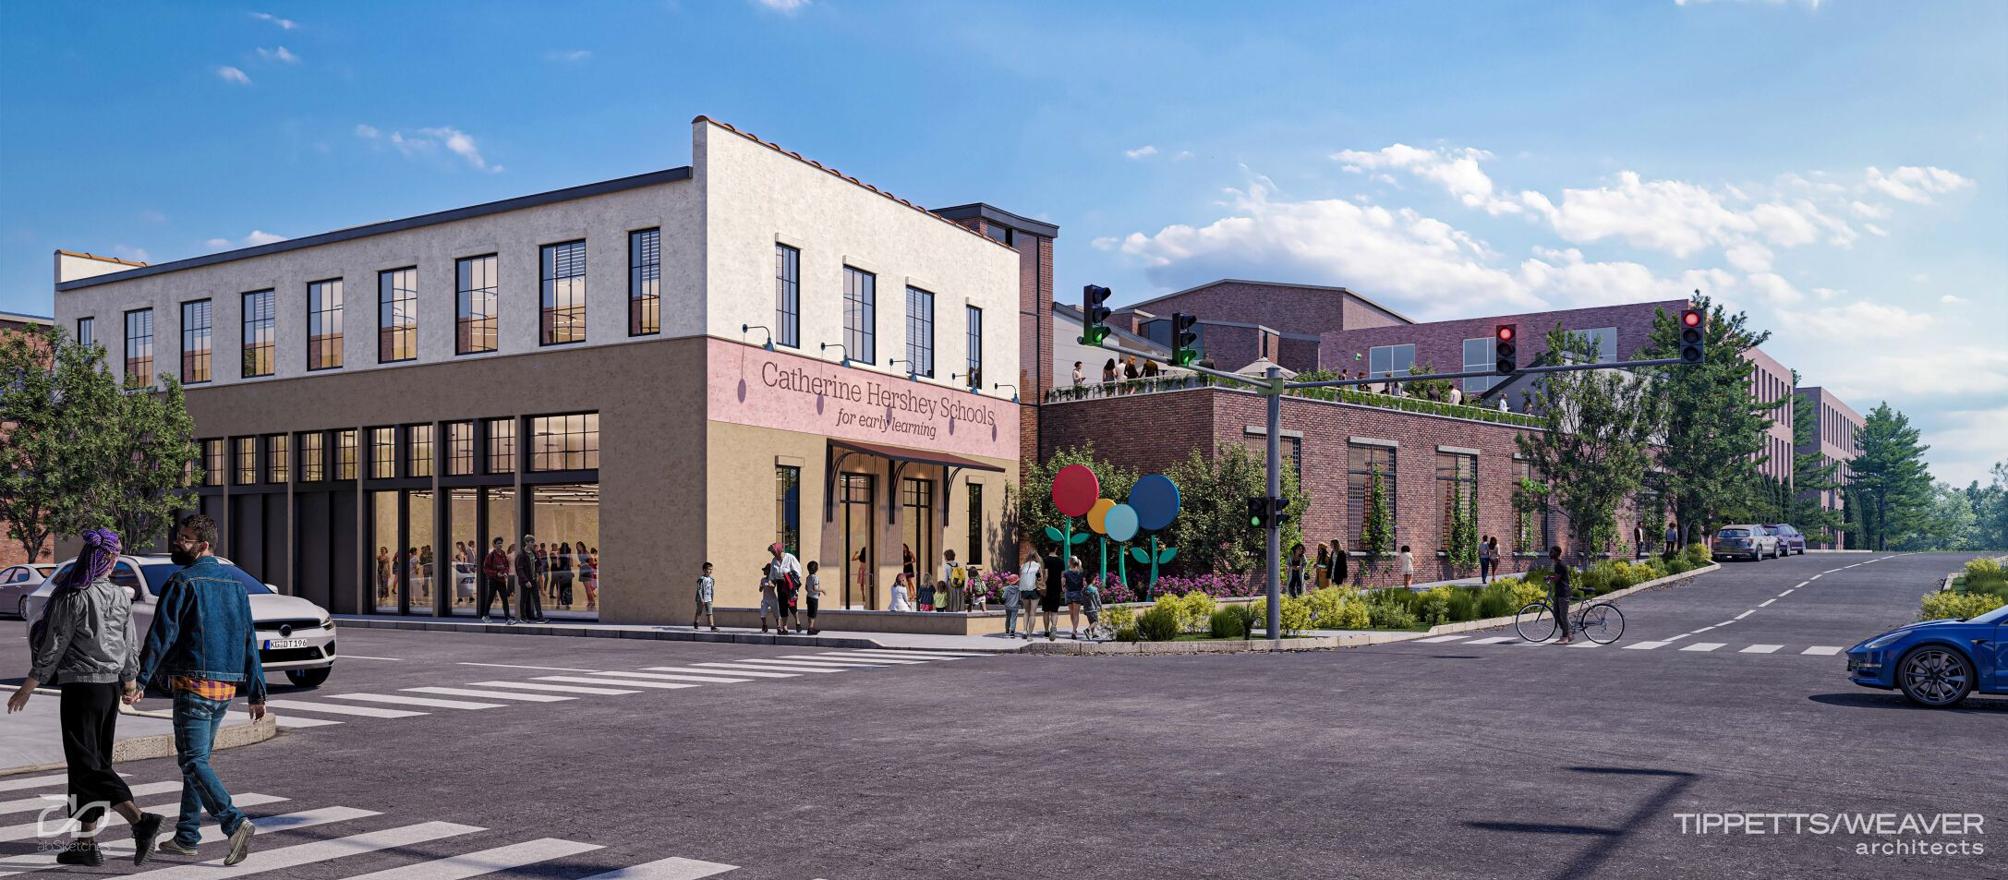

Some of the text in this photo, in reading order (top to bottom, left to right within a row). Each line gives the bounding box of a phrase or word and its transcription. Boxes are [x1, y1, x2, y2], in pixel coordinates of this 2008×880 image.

[762, 361, 995, 426] Catherine Hershey Schools
[836, 408, 937, 440] for early learning
